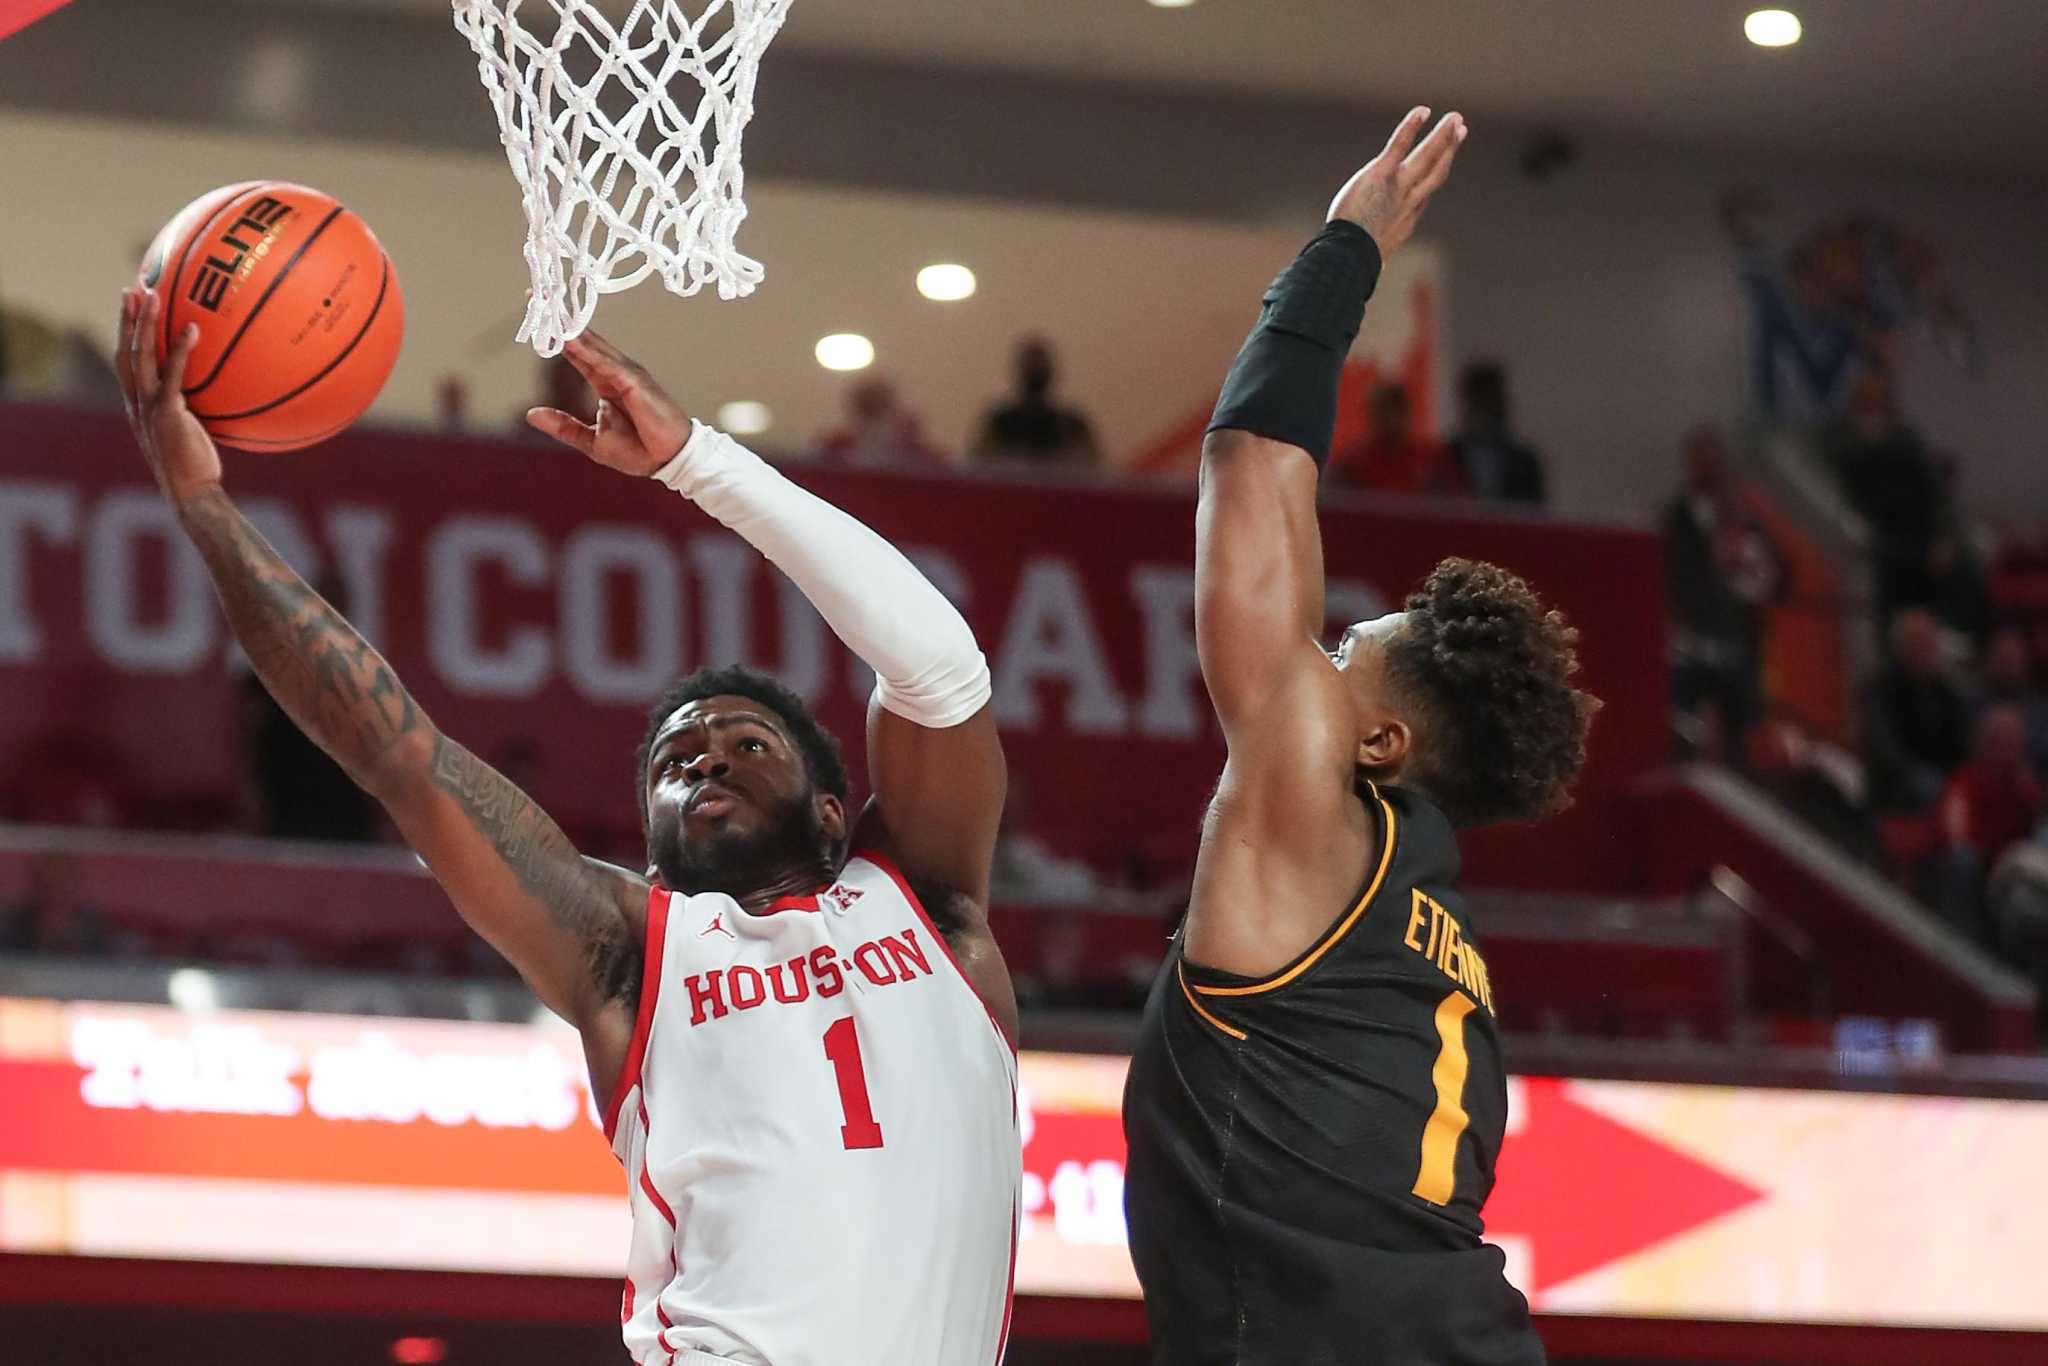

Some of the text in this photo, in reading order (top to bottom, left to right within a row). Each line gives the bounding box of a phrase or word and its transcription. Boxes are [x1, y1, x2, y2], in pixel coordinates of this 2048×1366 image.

[188, 196, 293, 312] ELITE
[684, 927, 934, 1027] HOUSON
[822, 1015, 884, 1151] 1
[1411, 990, 1478, 1207] 1
